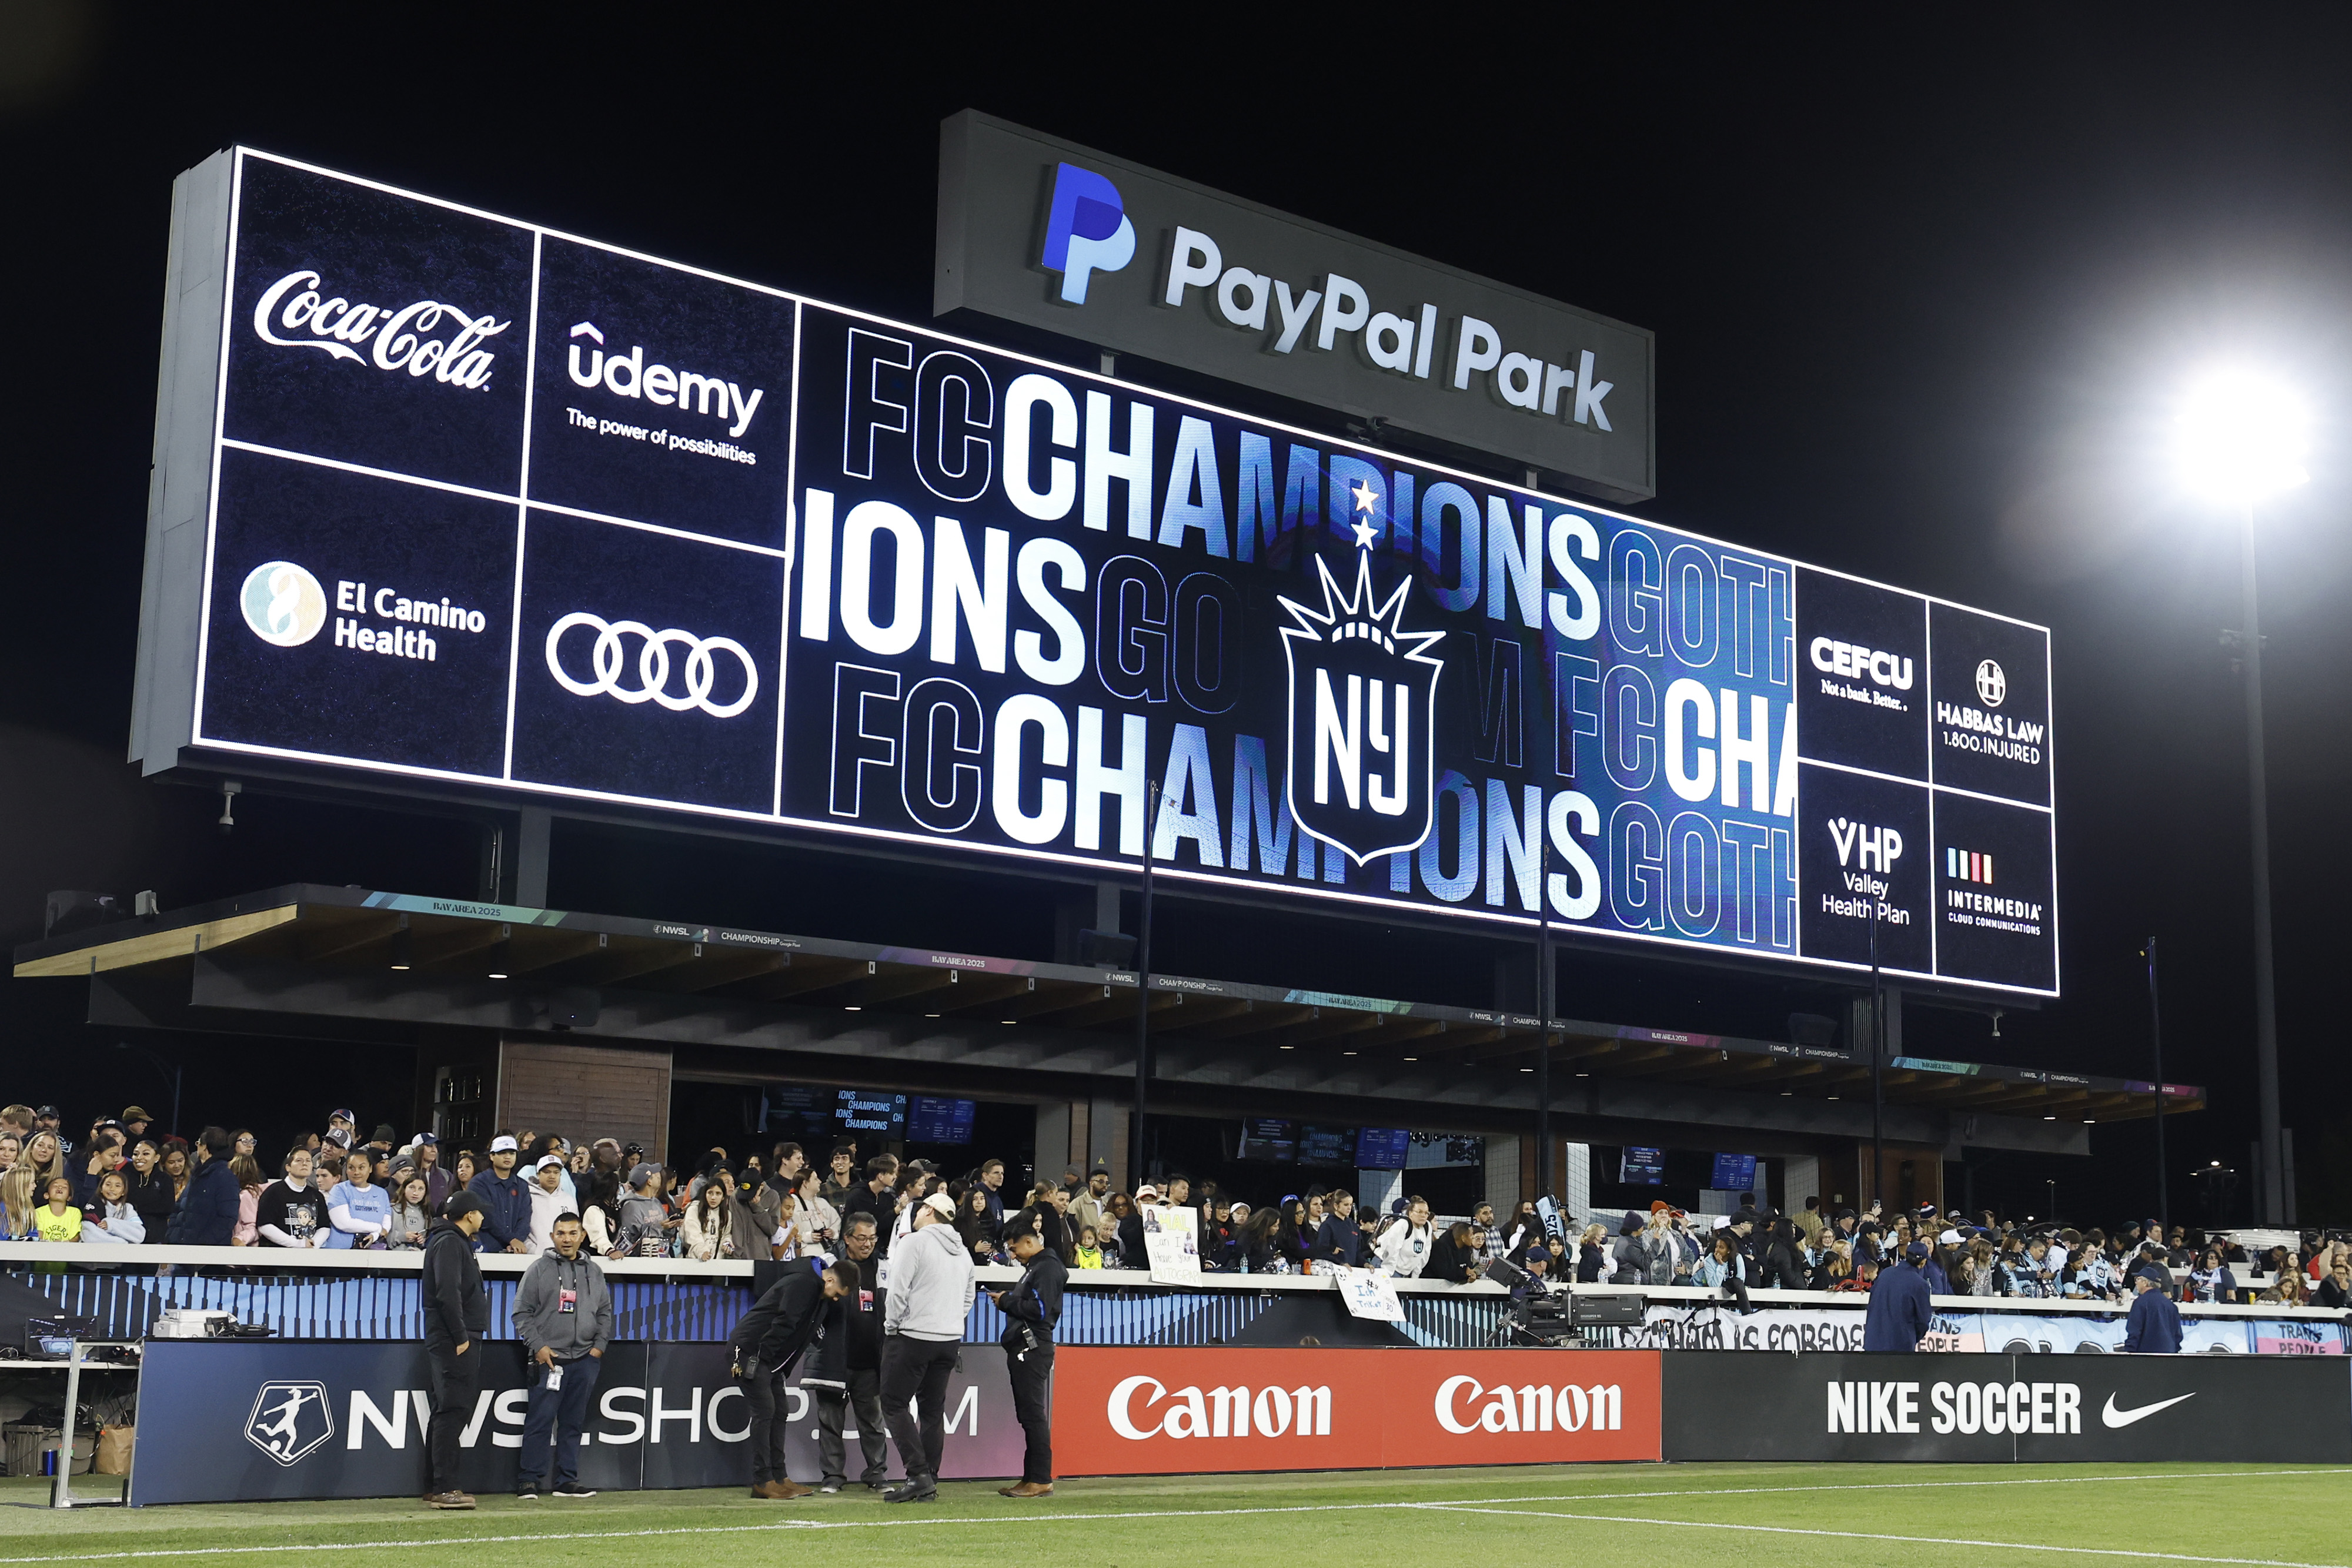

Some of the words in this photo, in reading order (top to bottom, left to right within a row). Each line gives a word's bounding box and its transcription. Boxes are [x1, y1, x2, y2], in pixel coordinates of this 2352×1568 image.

[254, 270, 511, 389] Coca-Cola
[1165, 225, 1438, 355] PayPal
[1454, 315, 1614, 432] Park
[566, 407, 597, 430] The
[599, 419, 649, 441] power
[650, 429, 667, 445] of
[669, 434, 757, 465] possibilities
[800, 487, 1087, 686] IONS
[336, 580, 366, 614] El
[374, 587, 486, 633] Camino
[335, 617, 436, 661] Health
[1810, 637, 1913, 690] CEFCU
[1821, 679, 1839, 696] Not
[1840, 687, 1846, 698] a
[1846, 684, 1872, 704] bank.
[1937, 702, 2003, 736] HABBAS
[2007, 717, 2043, 744] LAW
[1314, 668, 1409, 817] NY
[1943, 731, 2040, 764] 1.800.INJURED
[1828, 818, 1903, 874] VHP
[1843, 871, 1889, 900] Valley
[433, 902, 452, 911] BAY
[452, 905, 477, 914] AREA
[478, 907, 501, 917] 2025
[1823, 894, 1872, 919] Health
[1877, 902, 1910, 925] Plan
[1948, 890, 2040, 921] INTERMEDIA
[662, 926, 690, 935] NWSL
[1948, 912, 1973, 925] CLOUD
[1976, 917, 2040, 935] COMMUNICATIONS
[721, 932, 780, 945] CHAMPIONSHIP
[946, 957, 966, 965] AREA
[967, 959, 985, 967] 2025
[1112, 974, 1134, 982] NWSL
[1159, 978, 1206, 989] CHAMPONSHIP
[1513, 1017, 1551, 1027] CHAMPIONP
[1805, 1049, 1838, 1058] CHAMPIONSHIP
[838, 1090, 856, 1100] IONS
[848, 1100, 890, 1112] CHAMPIONS
[836, 1109, 853, 1119] IONS
[846, 1119, 888, 1130] CHAMPIONS
[45, 1225, 69, 1238] TIGERS
[1158, 1213, 1191, 1232] HAL
[1152, 1235, 1170, 1247] Can
[1175, 1236, 1181, 1248] I
[1153, 1251, 1172, 1263] Have
[1178, 1253, 1193, 1263] your
[1355, 1285, 1375, 1296] Ich
[1768, 1322, 1867, 1351] FOREVE
[1917, 1336, 1961, 1353] EOPLE
[2278, 1323, 2323, 1344] TRANS
[1107, 1375, 1331, 1440] Canon
[1435, 1375, 1621, 1434] Canon
[1828, 1382, 1919, 1433] NIKE
[1932, 1382, 2081, 1435] SOCCER
